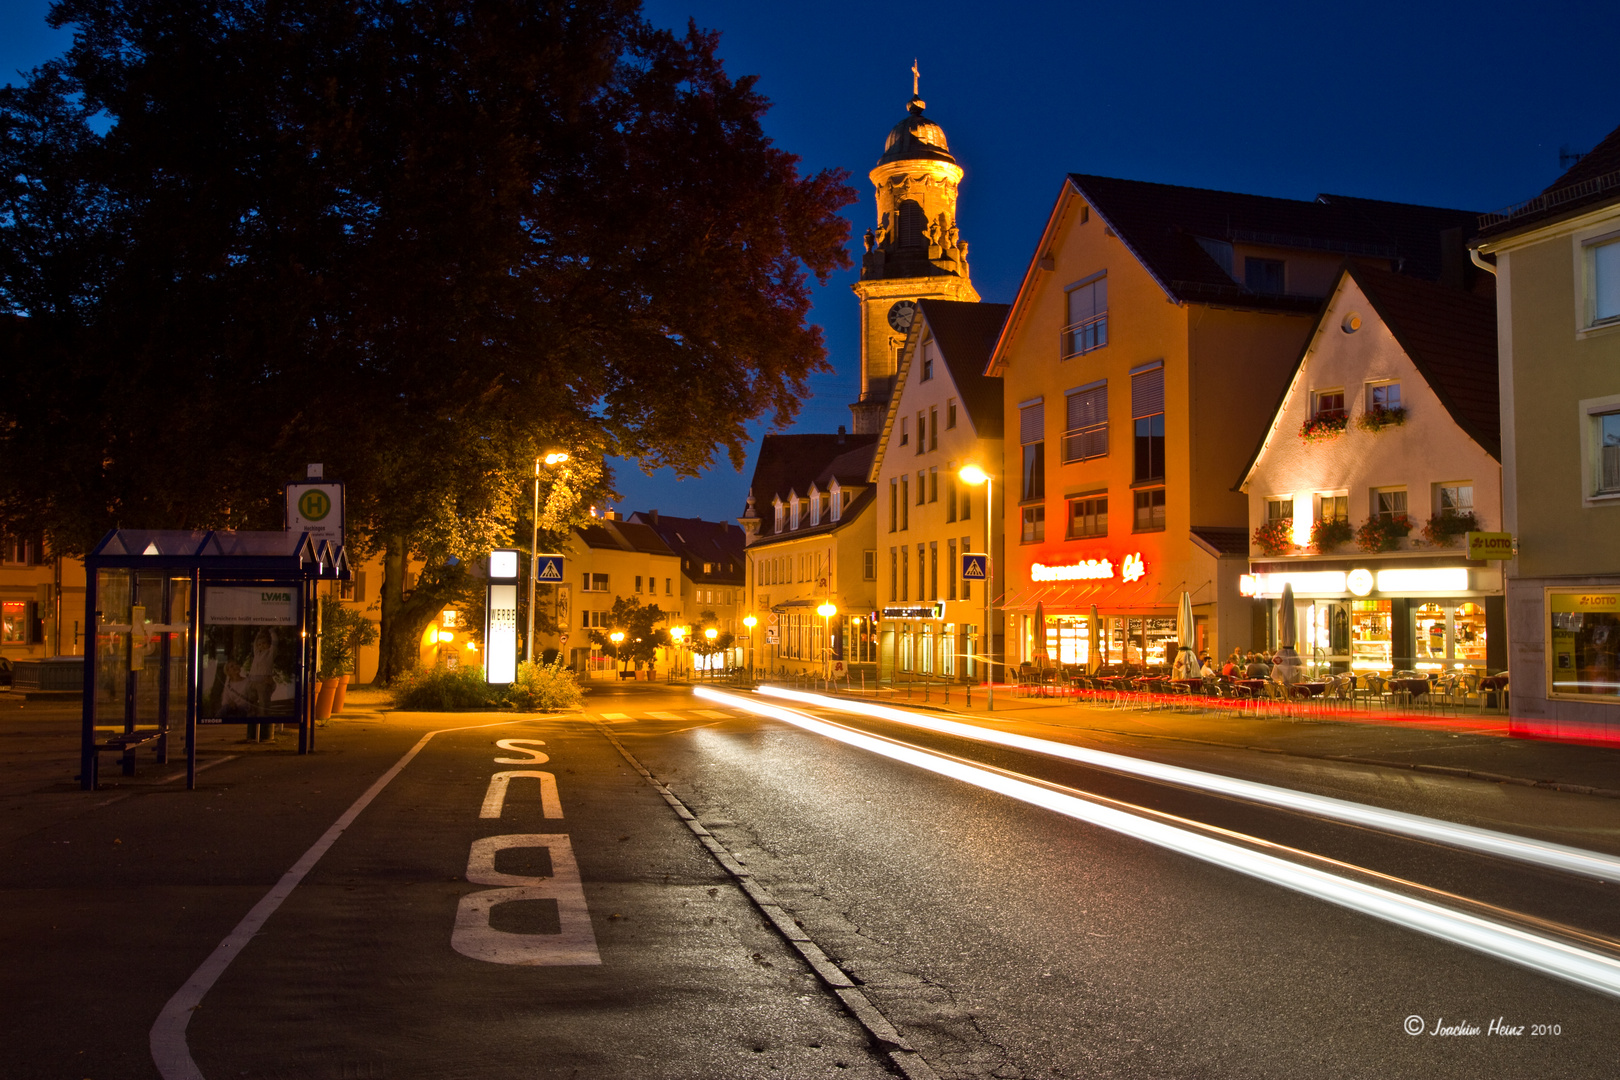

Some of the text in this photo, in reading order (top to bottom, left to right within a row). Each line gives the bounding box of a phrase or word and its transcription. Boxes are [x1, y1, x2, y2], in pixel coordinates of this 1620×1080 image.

[307, 496, 322, 515] H
[1485, 538, 1511, 549] LOTTO
[261, 592, 282, 601] LVM
[1590, 596, 1617, 605] LOTTO
[491, 608, 515, 621] WERBE
